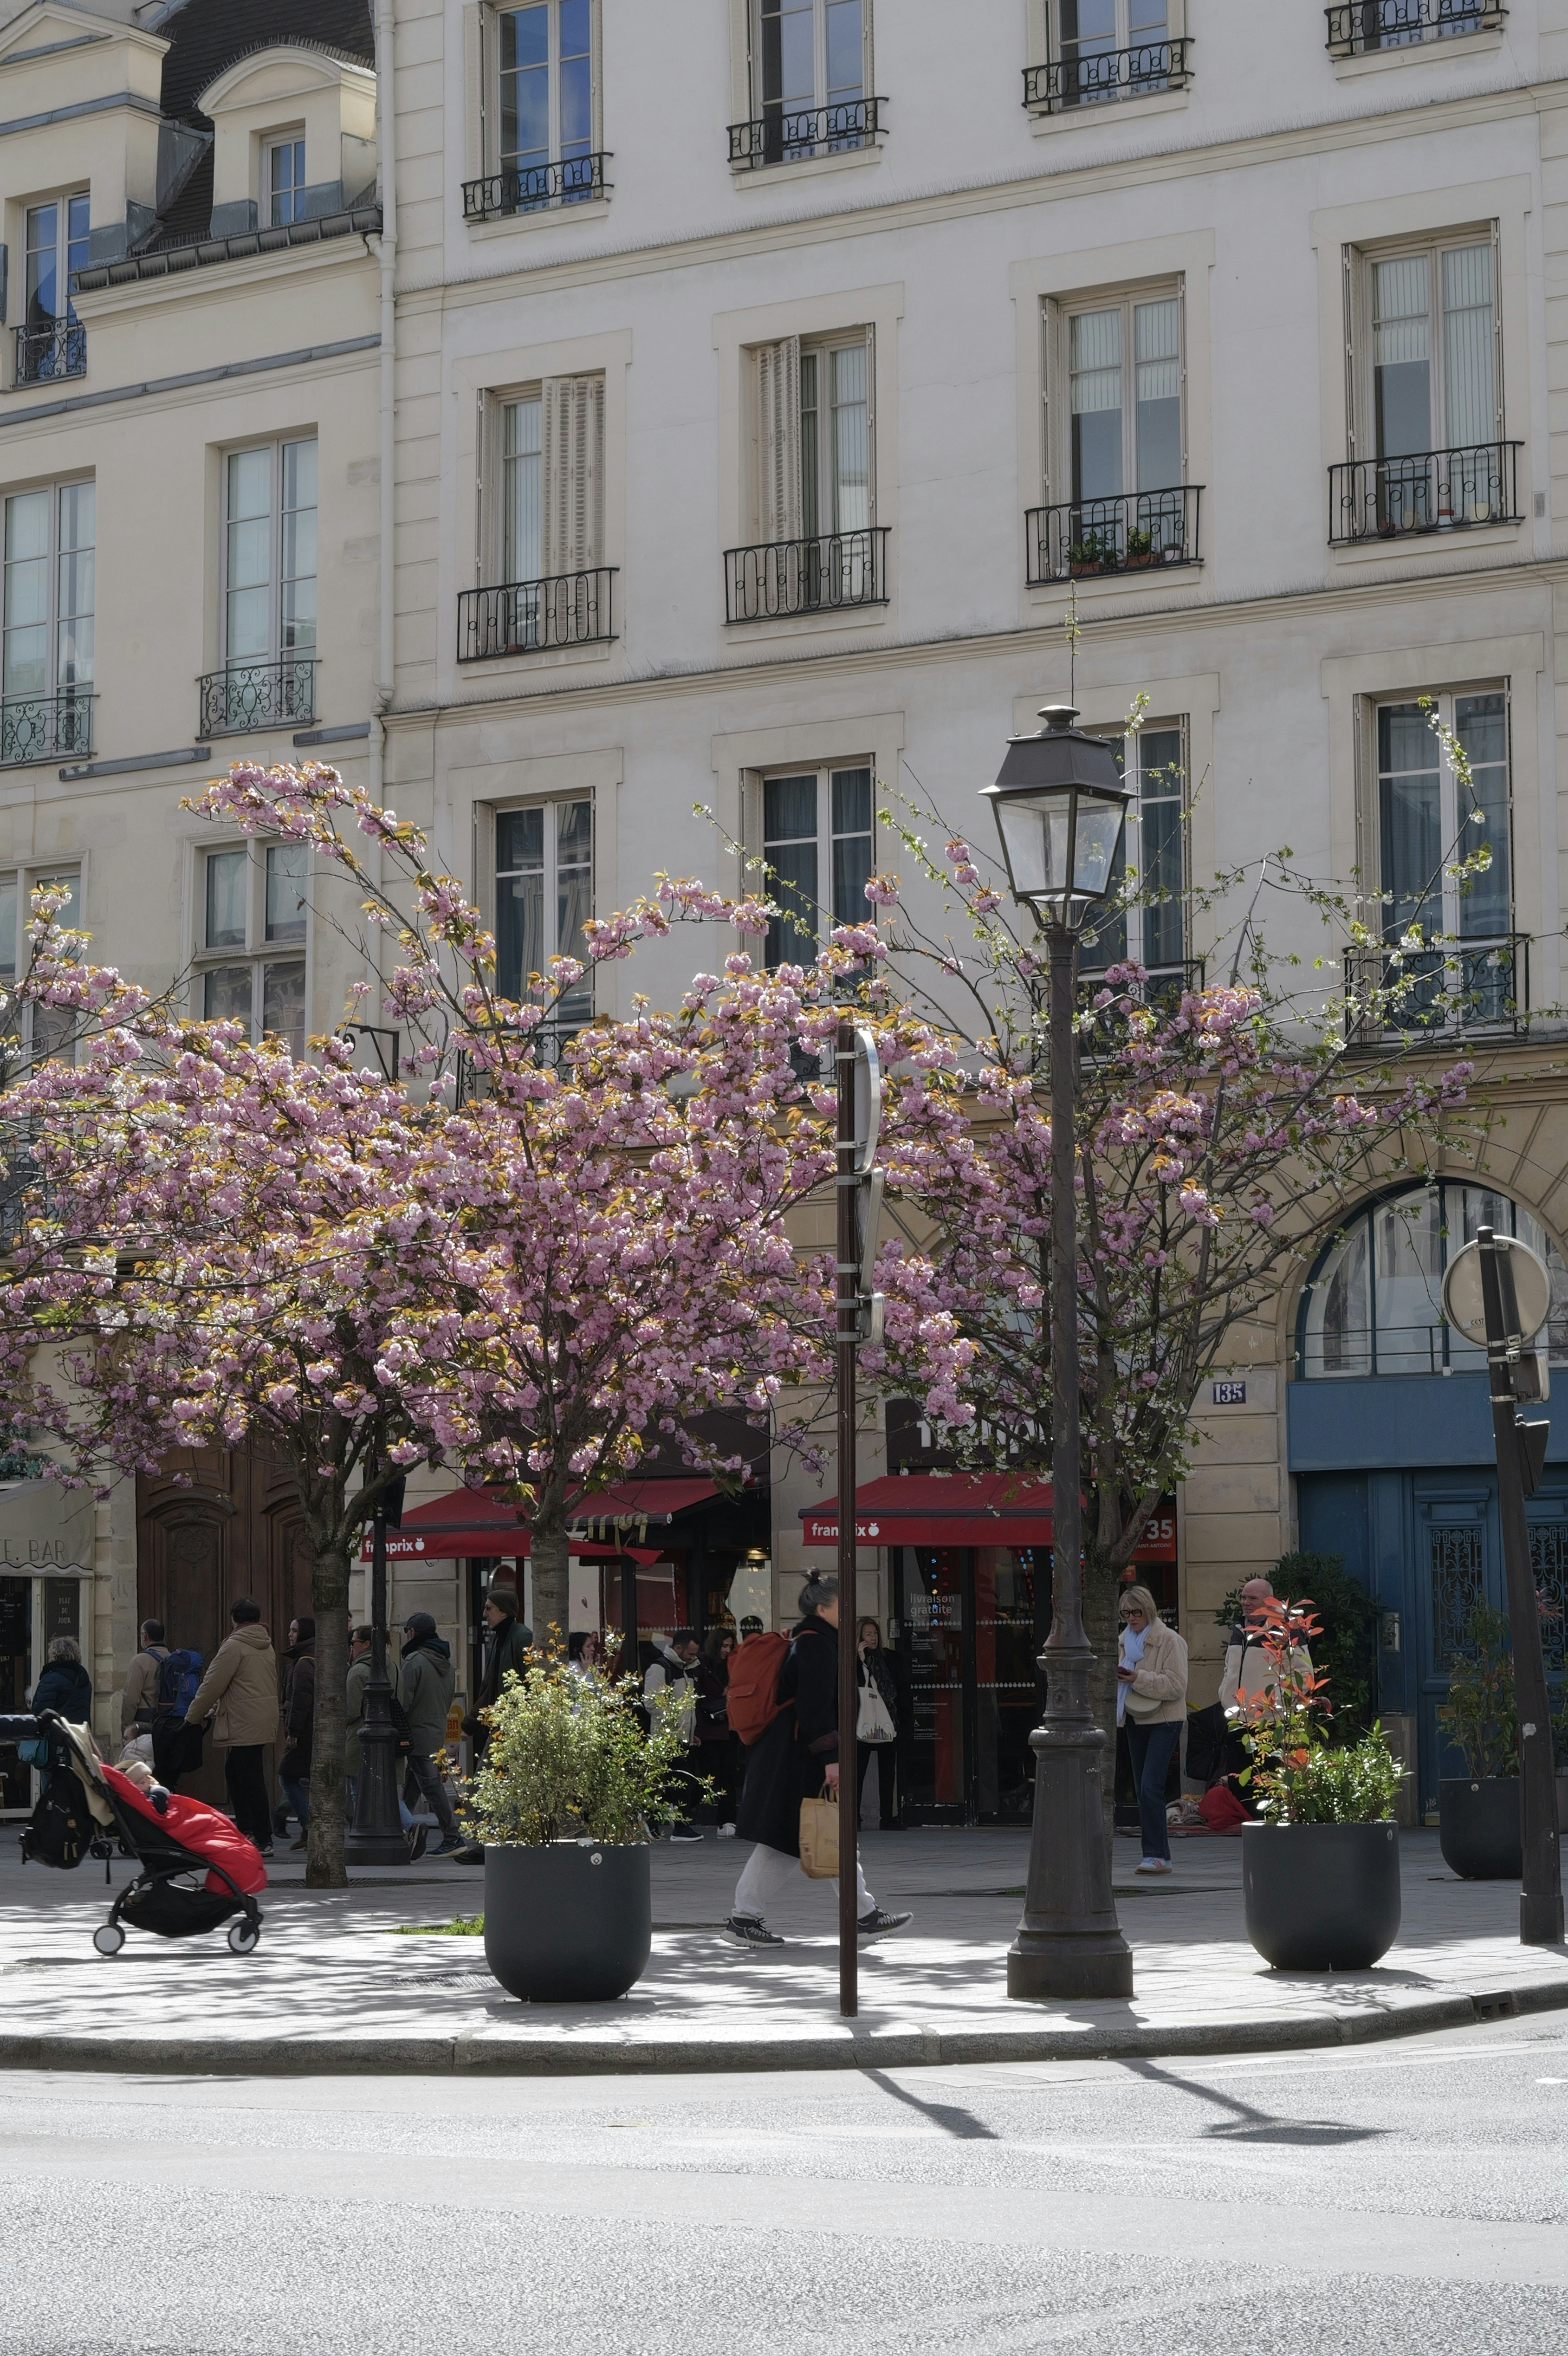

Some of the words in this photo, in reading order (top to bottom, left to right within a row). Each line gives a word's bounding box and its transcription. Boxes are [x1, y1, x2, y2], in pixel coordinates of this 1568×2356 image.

[1214, 1383, 1243, 1402] 135
[811, 1523, 866, 1536] franix
[1141, 1519, 1173, 1540] 35
[29, 1540, 65, 1561] BAR
[910, 1593, 955, 1603] livraison
[910, 1604, 952, 1617] gratuite
